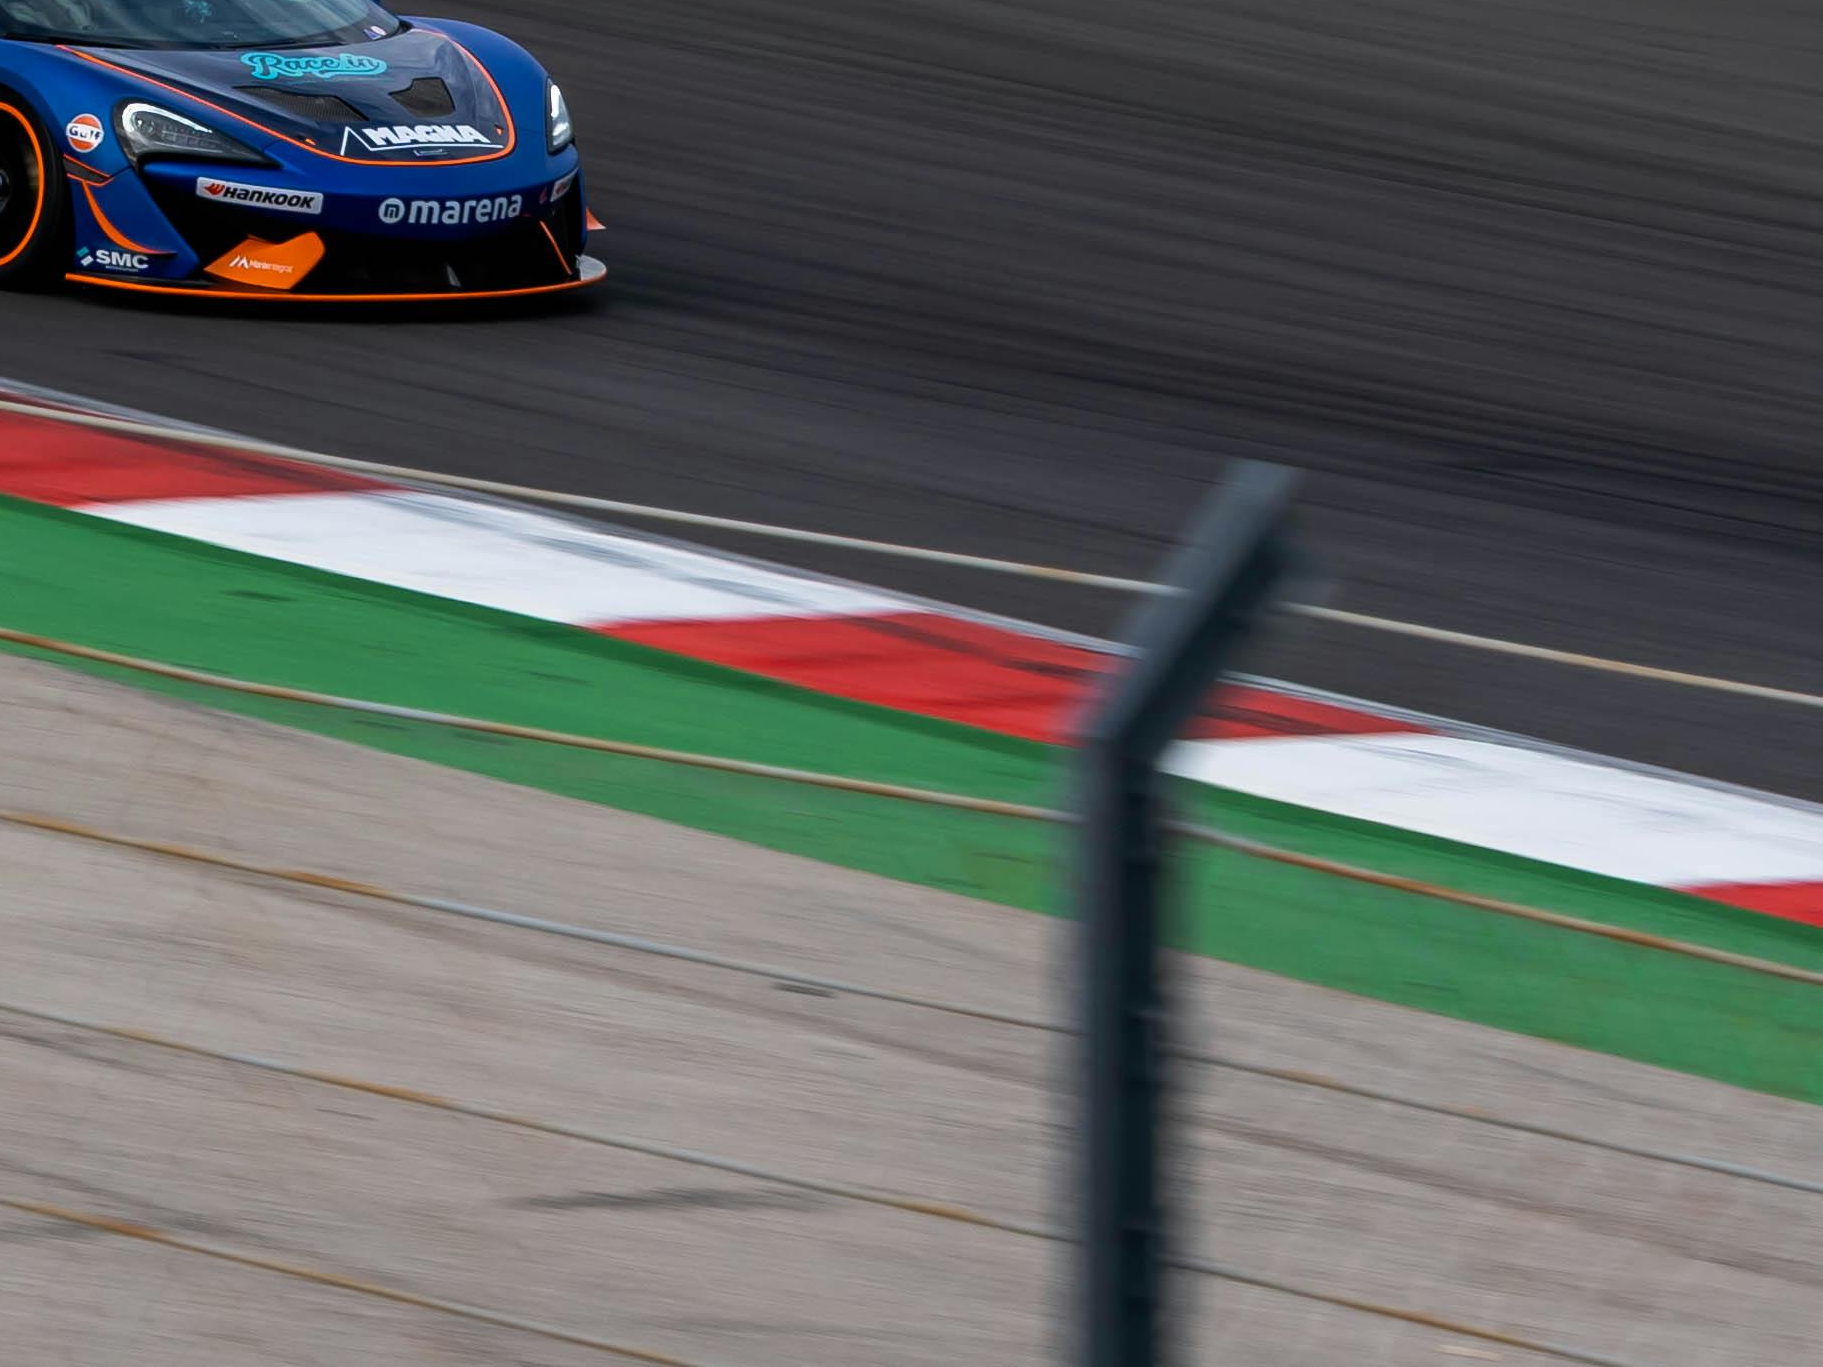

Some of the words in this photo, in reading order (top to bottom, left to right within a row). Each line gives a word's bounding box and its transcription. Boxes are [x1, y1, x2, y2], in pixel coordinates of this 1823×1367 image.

[68, 124, 103, 141] Gulf
[362, 124, 491, 146] MAGNA
[407, 193, 523, 225] marena
[95, 249, 149, 270] SMC
